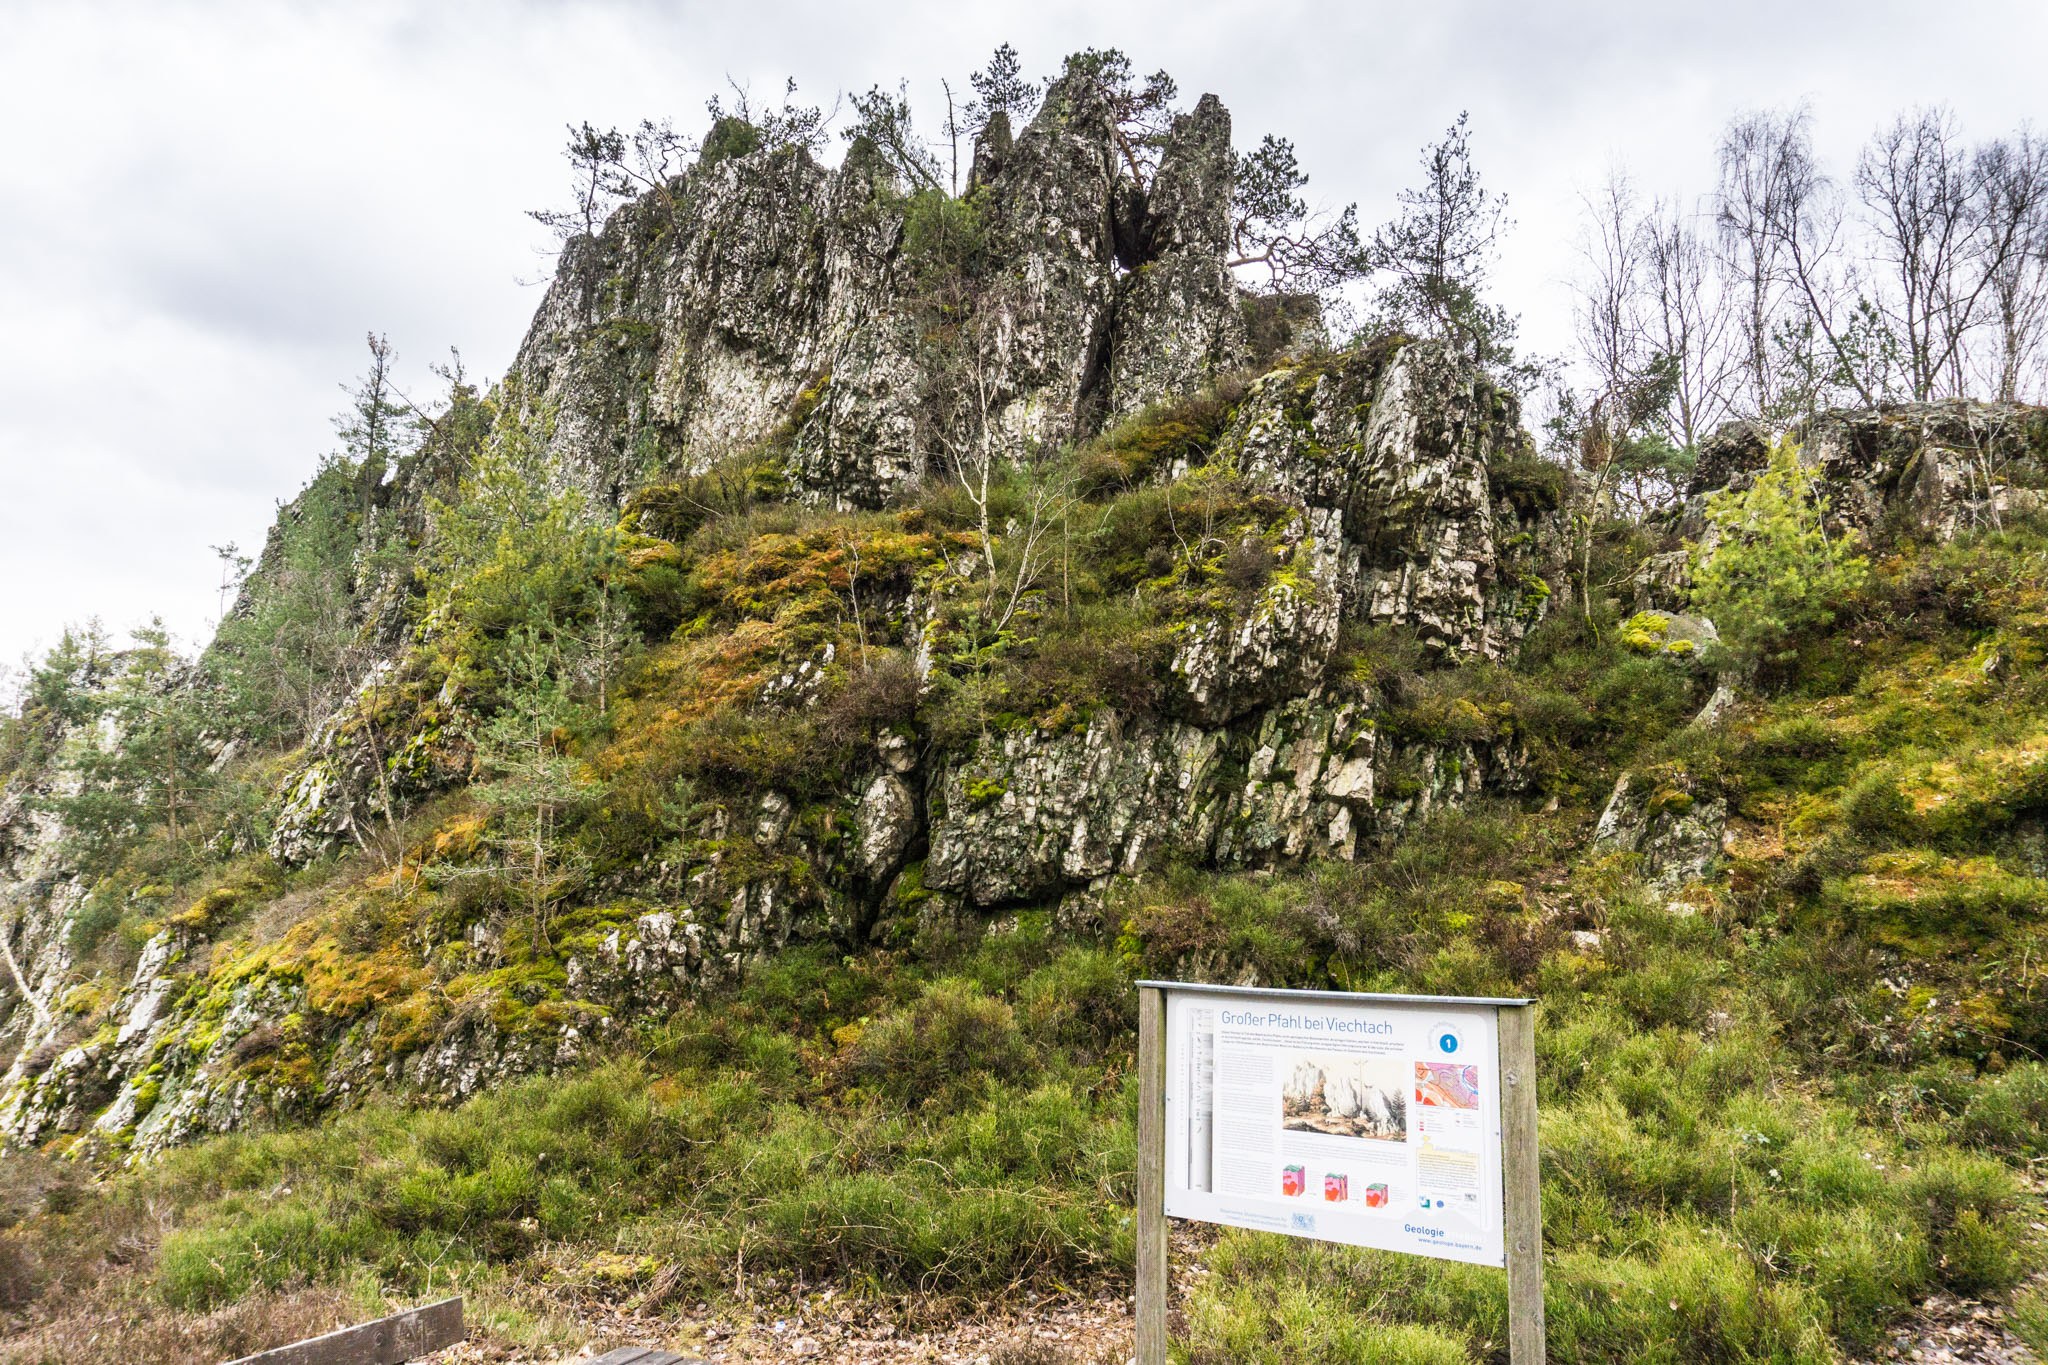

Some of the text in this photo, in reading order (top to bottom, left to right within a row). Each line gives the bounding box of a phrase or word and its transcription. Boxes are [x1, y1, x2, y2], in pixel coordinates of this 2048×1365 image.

[1221, 1010, 1266, 1027] Großer
[1268, 1013, 1301, 1030] Pfahl
[1304, 1016, 1324, 1031] bei
[1326, 1016, 1393, 1035] Viechtach
[1445, 1038, 1451, 1049] 1
[1404, 1223, 1445, 1237] Geologie
